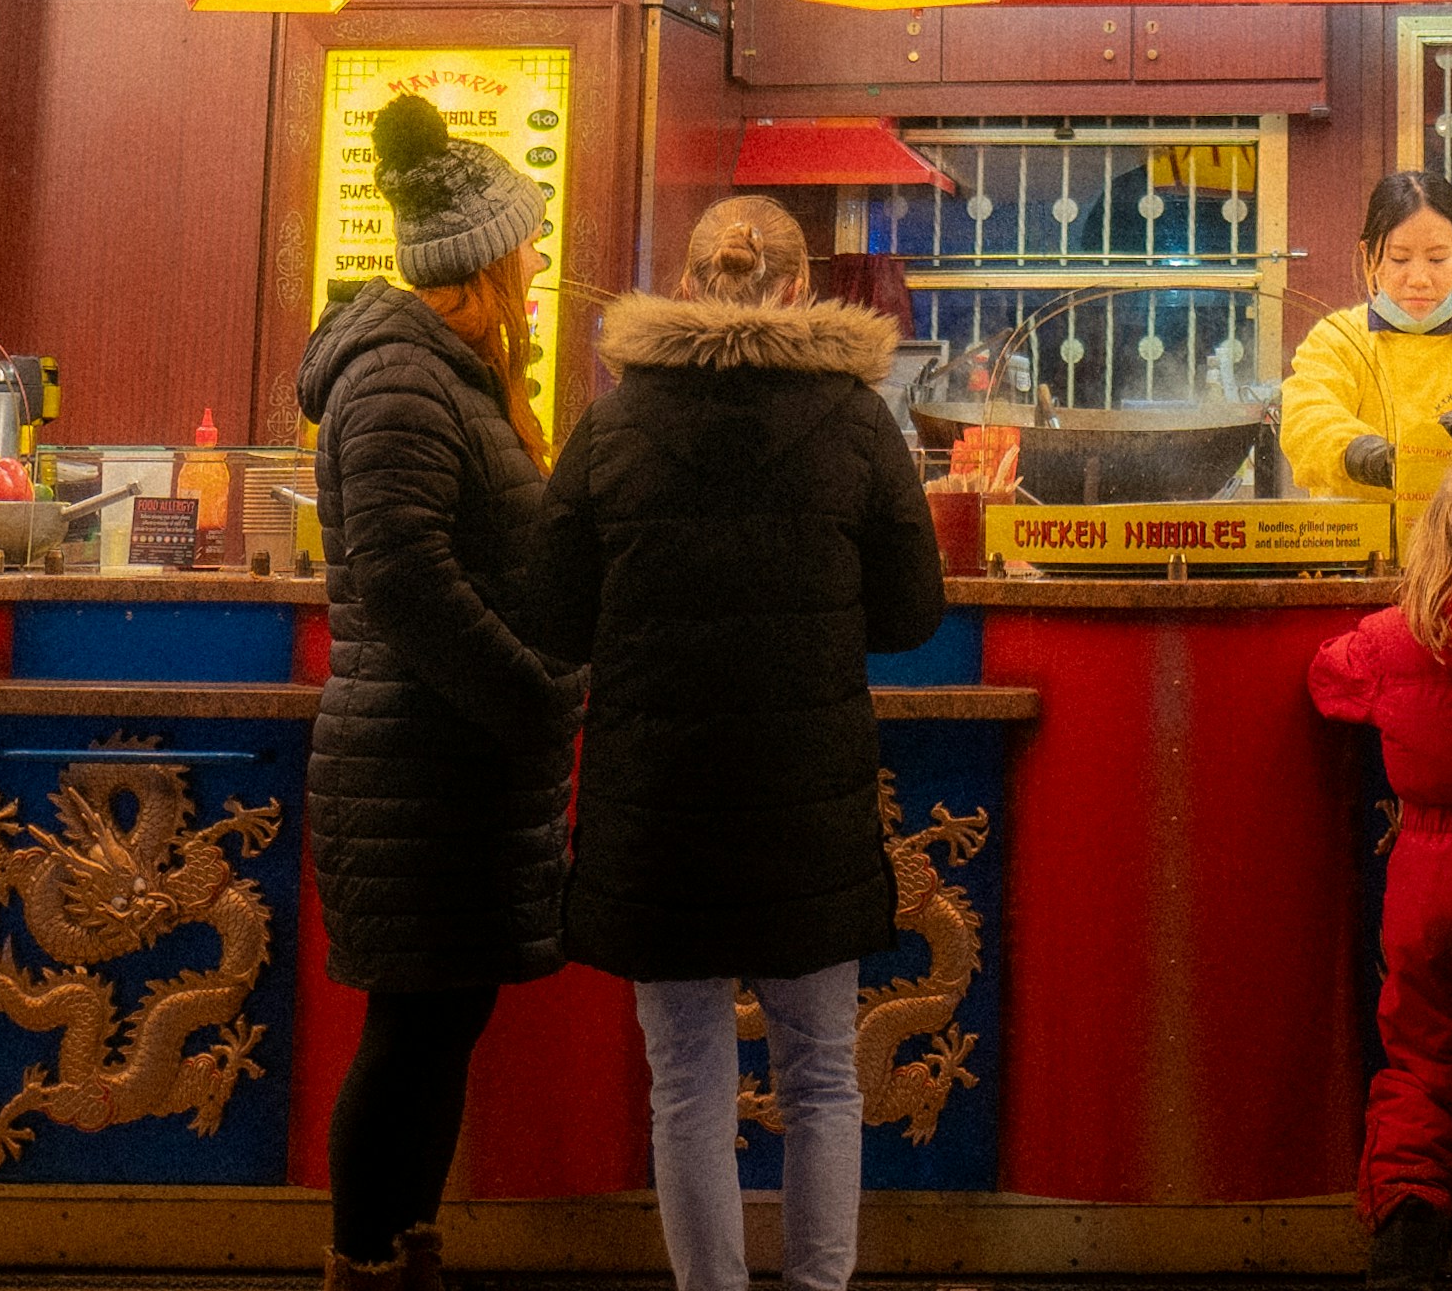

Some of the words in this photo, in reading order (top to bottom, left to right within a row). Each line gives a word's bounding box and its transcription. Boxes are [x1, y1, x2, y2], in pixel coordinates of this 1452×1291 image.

[387, 70, 510, 97] MANDARIN
[339, 220, 382, 234] THAI
[336, 255, 394, 270] SPRING
[137, 500, 159, 511] FOOD
[160, 500, 195, 513] ALLERGY?
[1013, 519, 1107, 549] CHICKEN
[1124, 519, 1247, 550] NOODLES
[1258, 521, 1297, 534] Noodles,
[1299, 520, 1325, 536] grilled
[1327, 522, 1359, 536] peppers
[1255, 537, 1272, 548] and
[1274, 537, 1301, 549] sliced
[1302, 536, 1334, 548] chicken
[1336, 536, 1361, 548] breast
